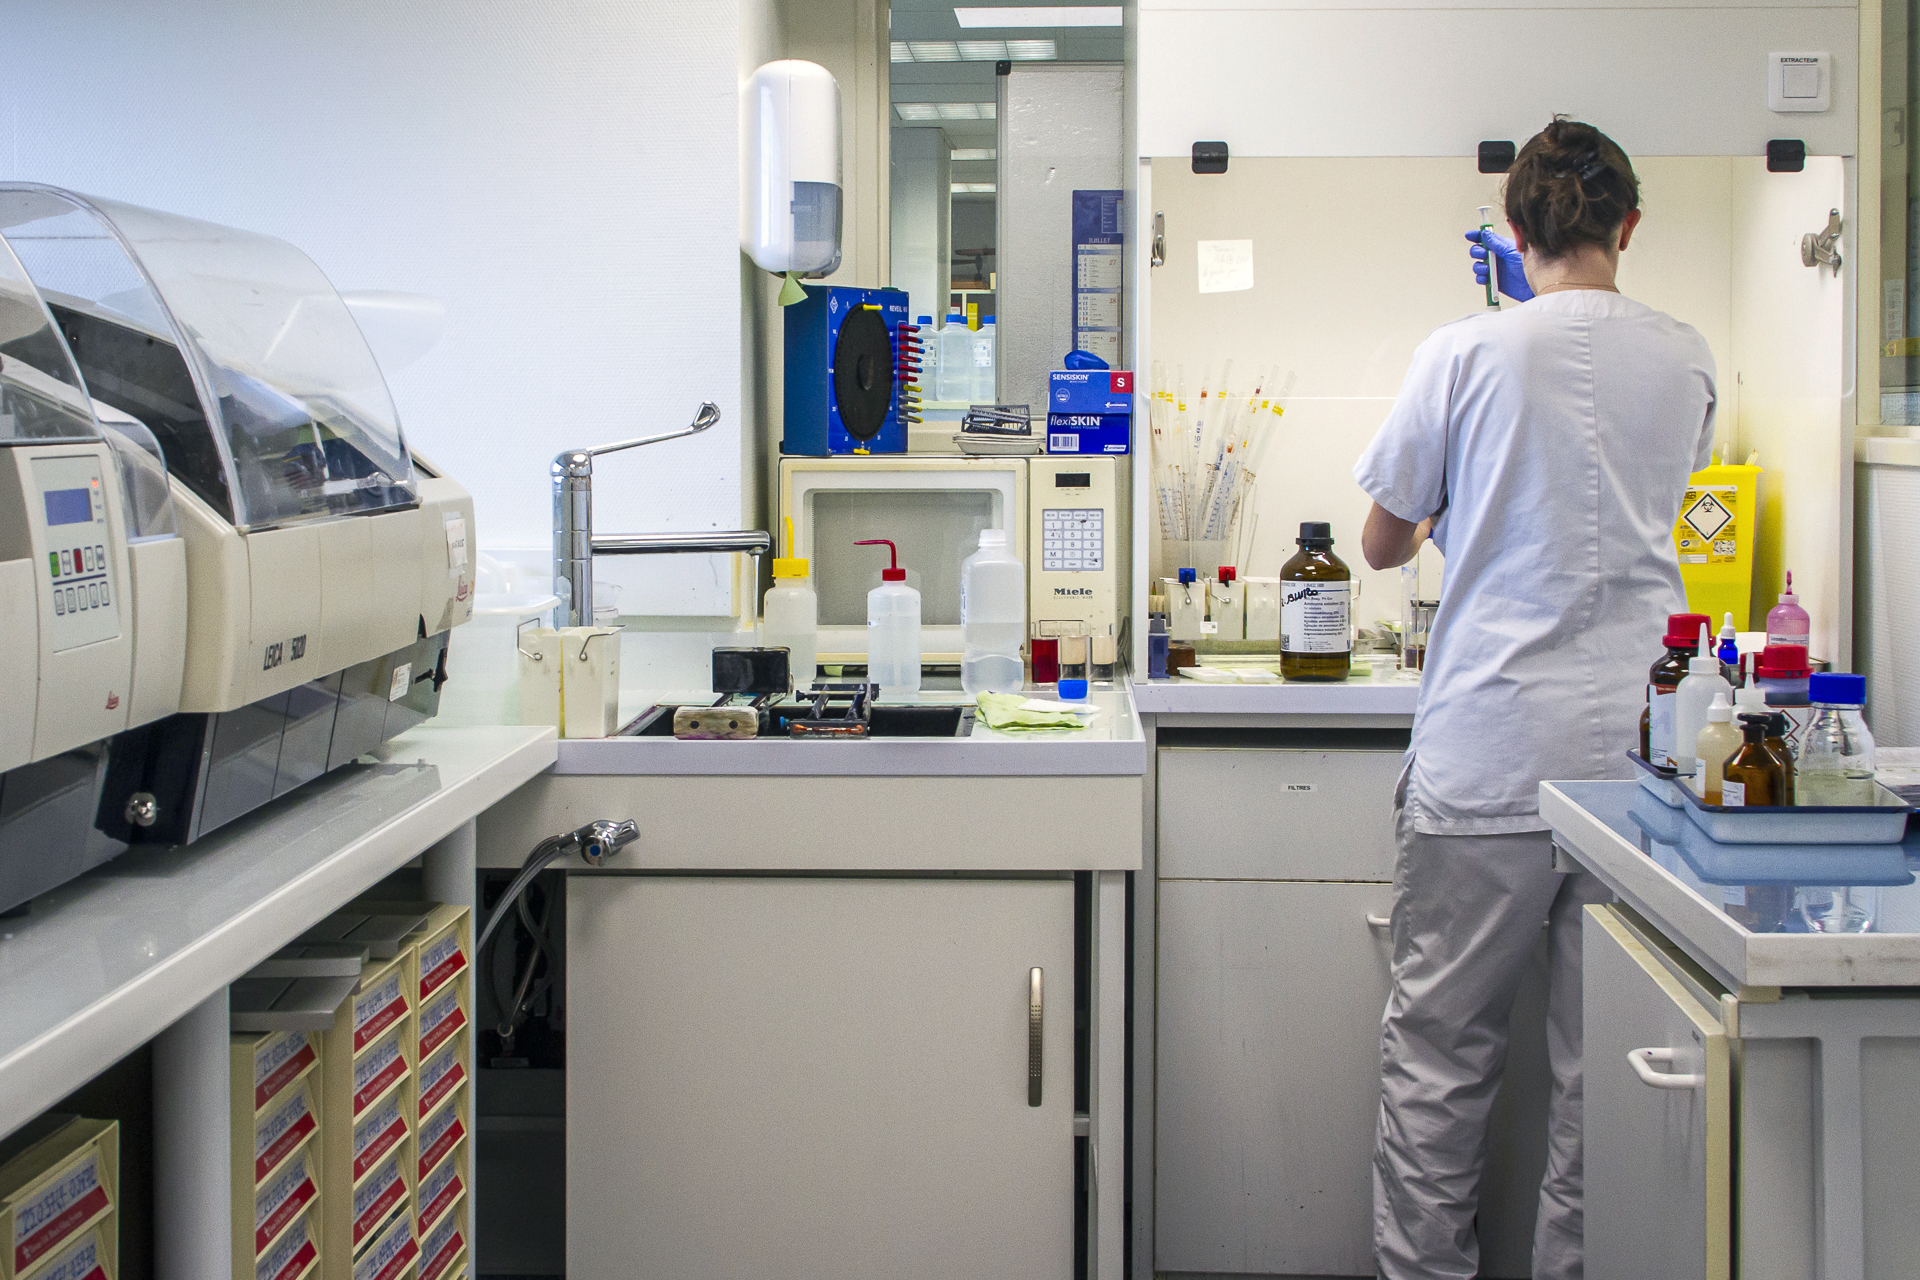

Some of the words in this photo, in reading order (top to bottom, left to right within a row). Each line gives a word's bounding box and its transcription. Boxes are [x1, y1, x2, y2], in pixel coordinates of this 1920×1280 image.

[1117, 377, 1125, 388] S
[263, 642, 283, 670] LEICA
[290, 634, 306, 661] 5020
